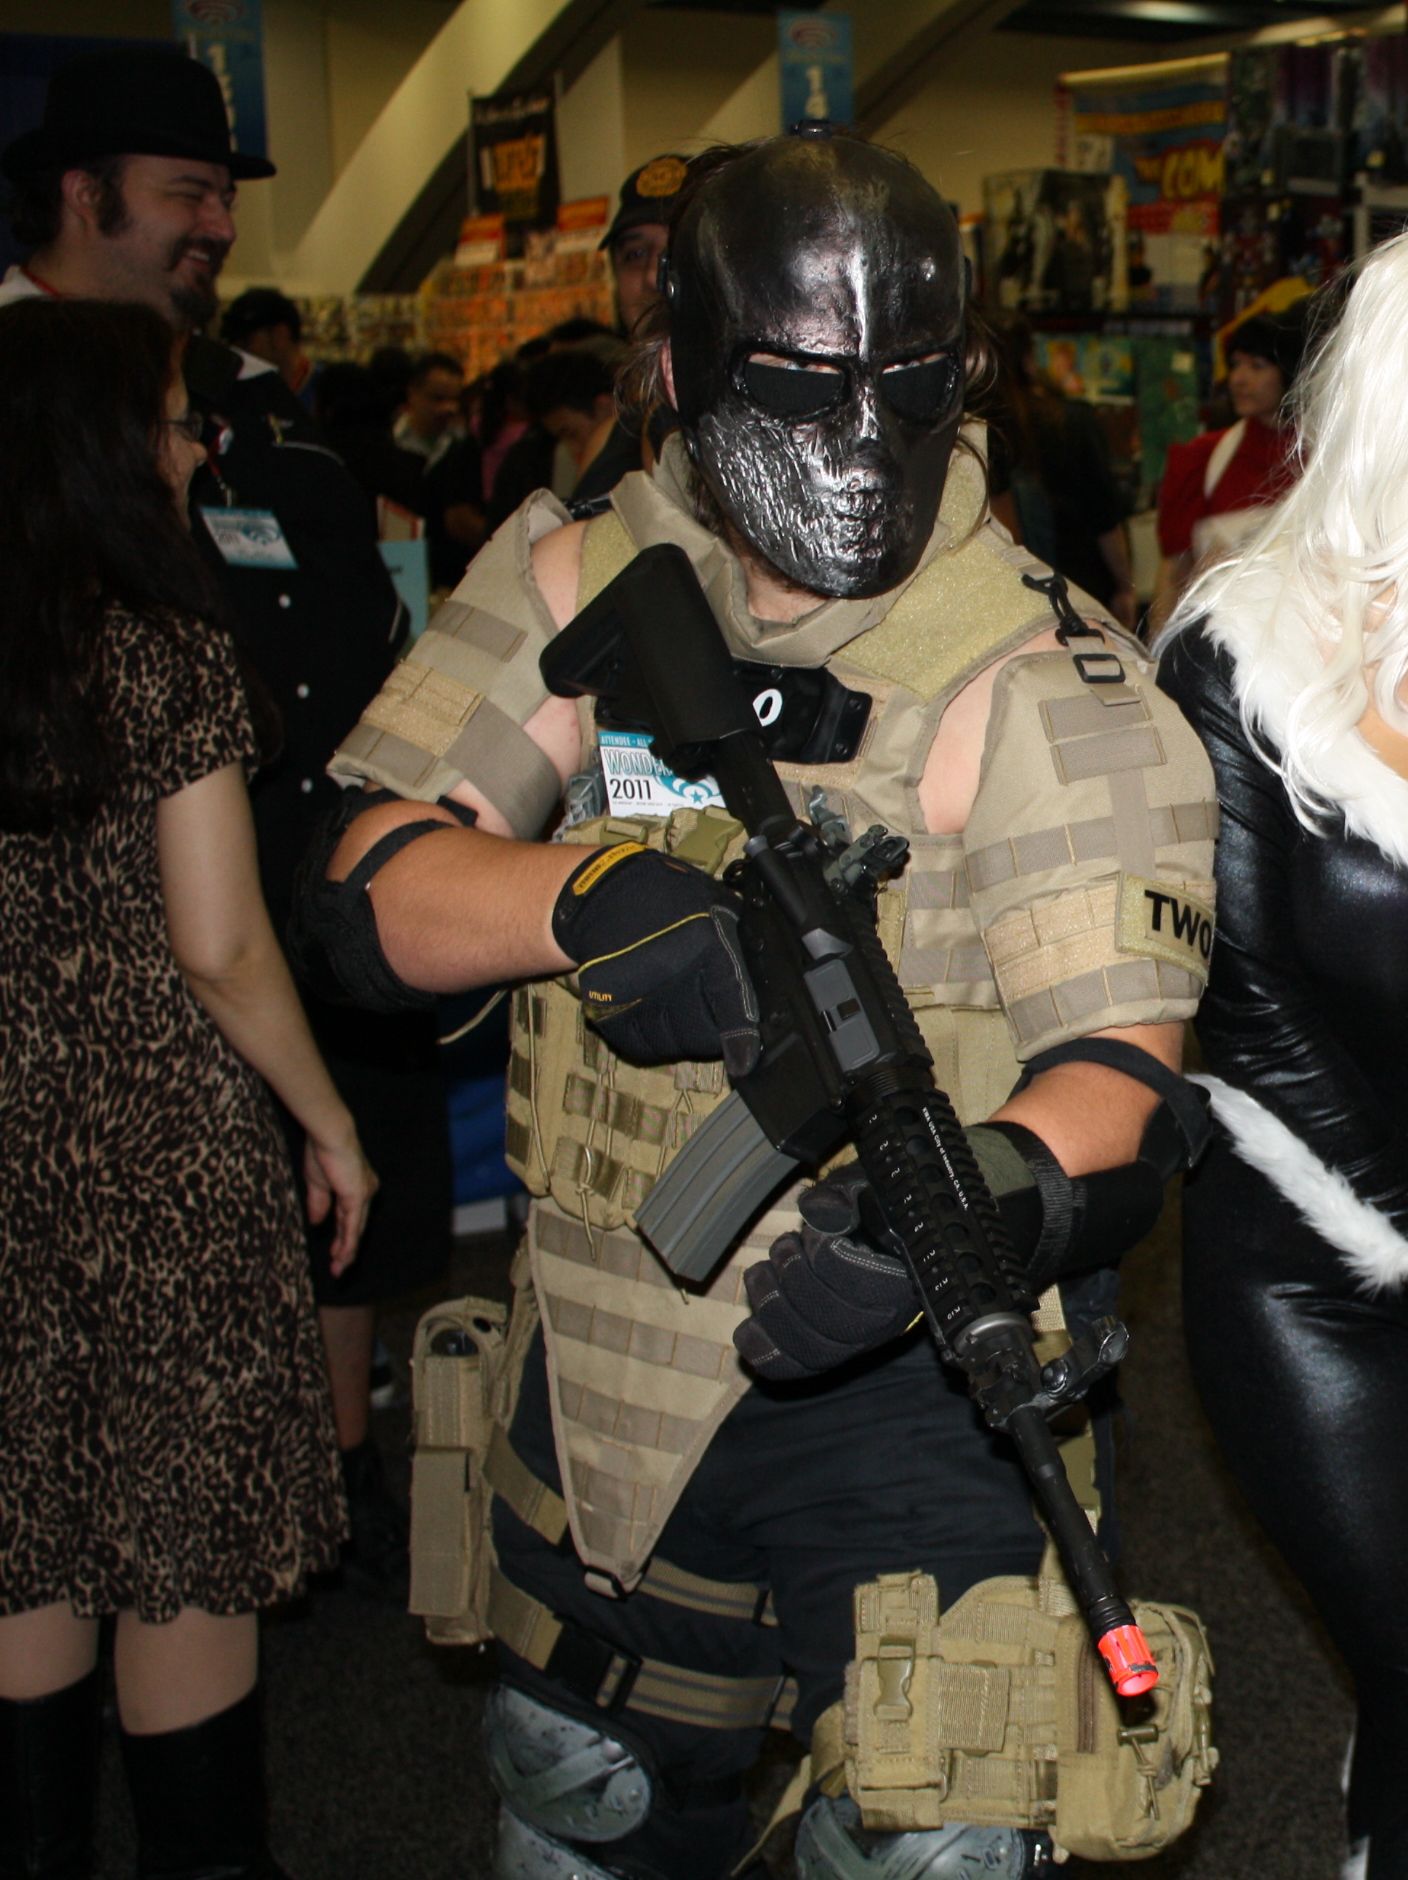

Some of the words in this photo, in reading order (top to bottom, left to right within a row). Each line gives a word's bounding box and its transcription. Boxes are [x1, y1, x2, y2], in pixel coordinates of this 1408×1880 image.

[601, 735, 630, 746] ATTENDEE
[609, 778, 652, 800] 2011
[1144, 889, 1212, 960] TWO
